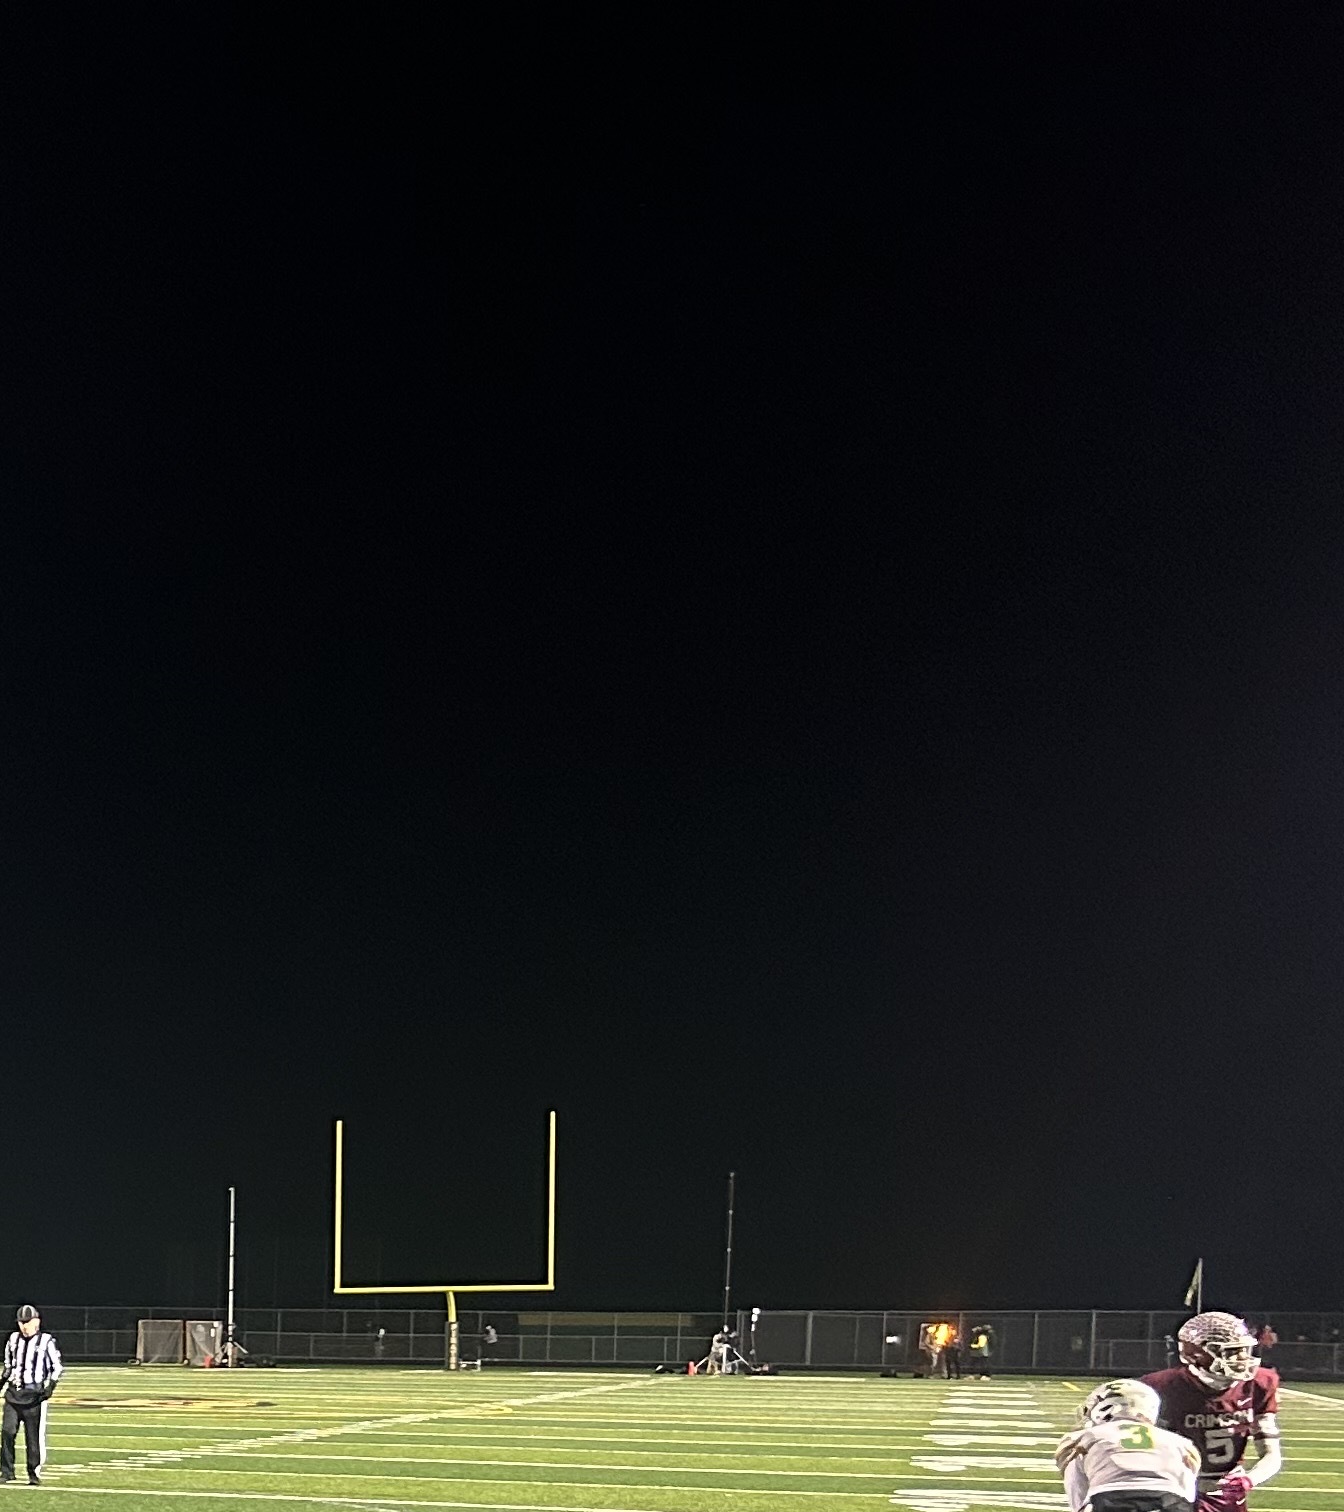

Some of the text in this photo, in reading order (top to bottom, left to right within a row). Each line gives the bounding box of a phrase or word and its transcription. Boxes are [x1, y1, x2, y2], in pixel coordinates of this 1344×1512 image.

[1184, 1408, 1254, 1428] CRIMSON
[1120, 1424, 1154, 1449] 3
[1204, 1428, 1234, 1465] 5
